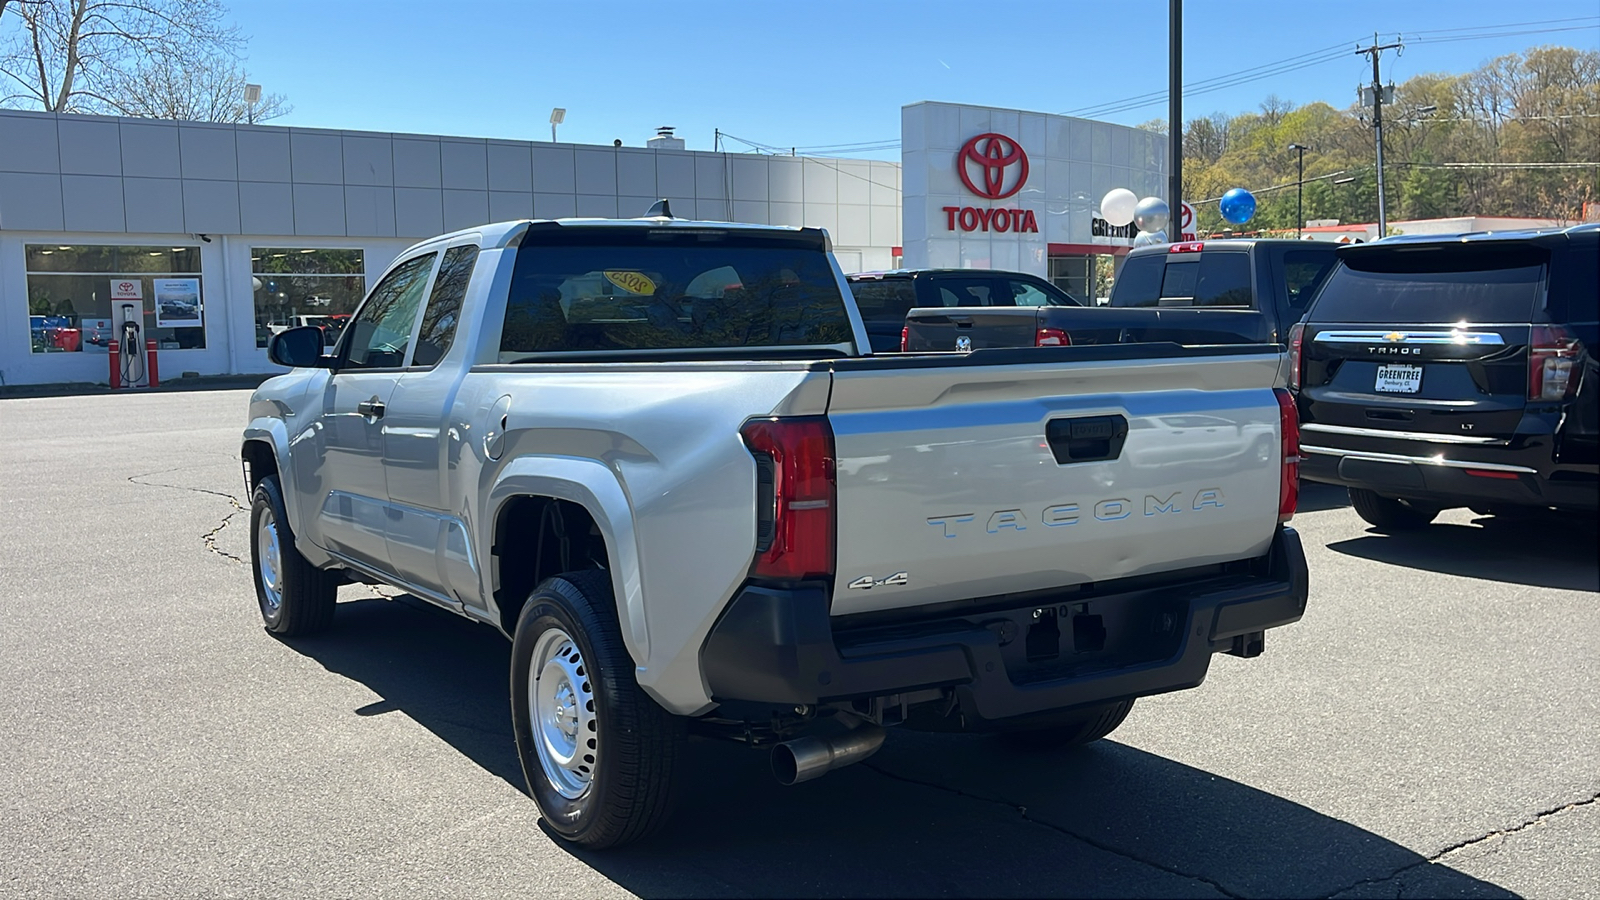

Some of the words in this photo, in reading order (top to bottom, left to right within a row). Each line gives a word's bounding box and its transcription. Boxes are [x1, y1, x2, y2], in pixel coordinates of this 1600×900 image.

[943, 206, 1038, 233] TOYOTA
[1368, 347, 1421, 355] TAHOE
[1379, 369, 1420, 380] GREENTREE
[927, 487, 1225, 538] TACOMA
[847, 570, 908, 590] 4x4
